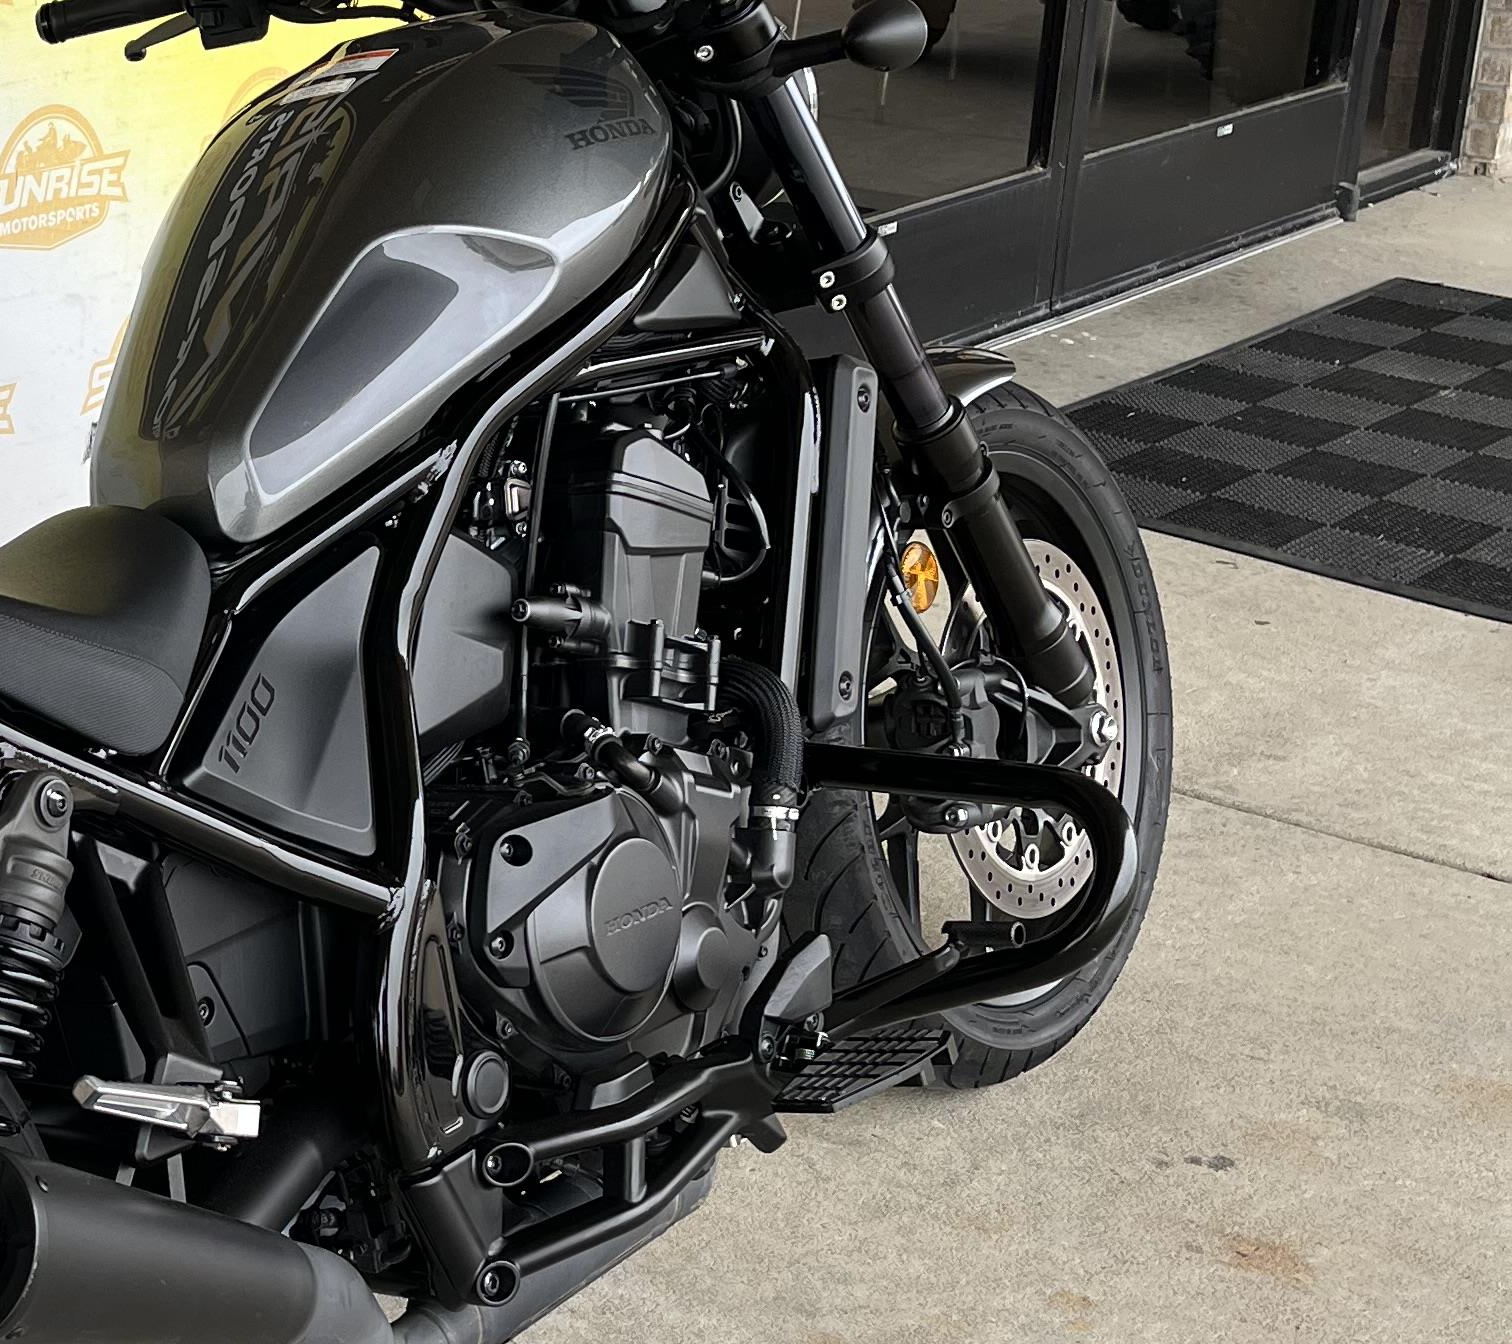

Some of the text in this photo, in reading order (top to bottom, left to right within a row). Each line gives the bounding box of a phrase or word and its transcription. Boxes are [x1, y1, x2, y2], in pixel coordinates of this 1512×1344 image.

[565, 117, 657, 151] HONDA
[217, 672, 276, 774] 1100
[604, 896, 675, 937] HONDA
